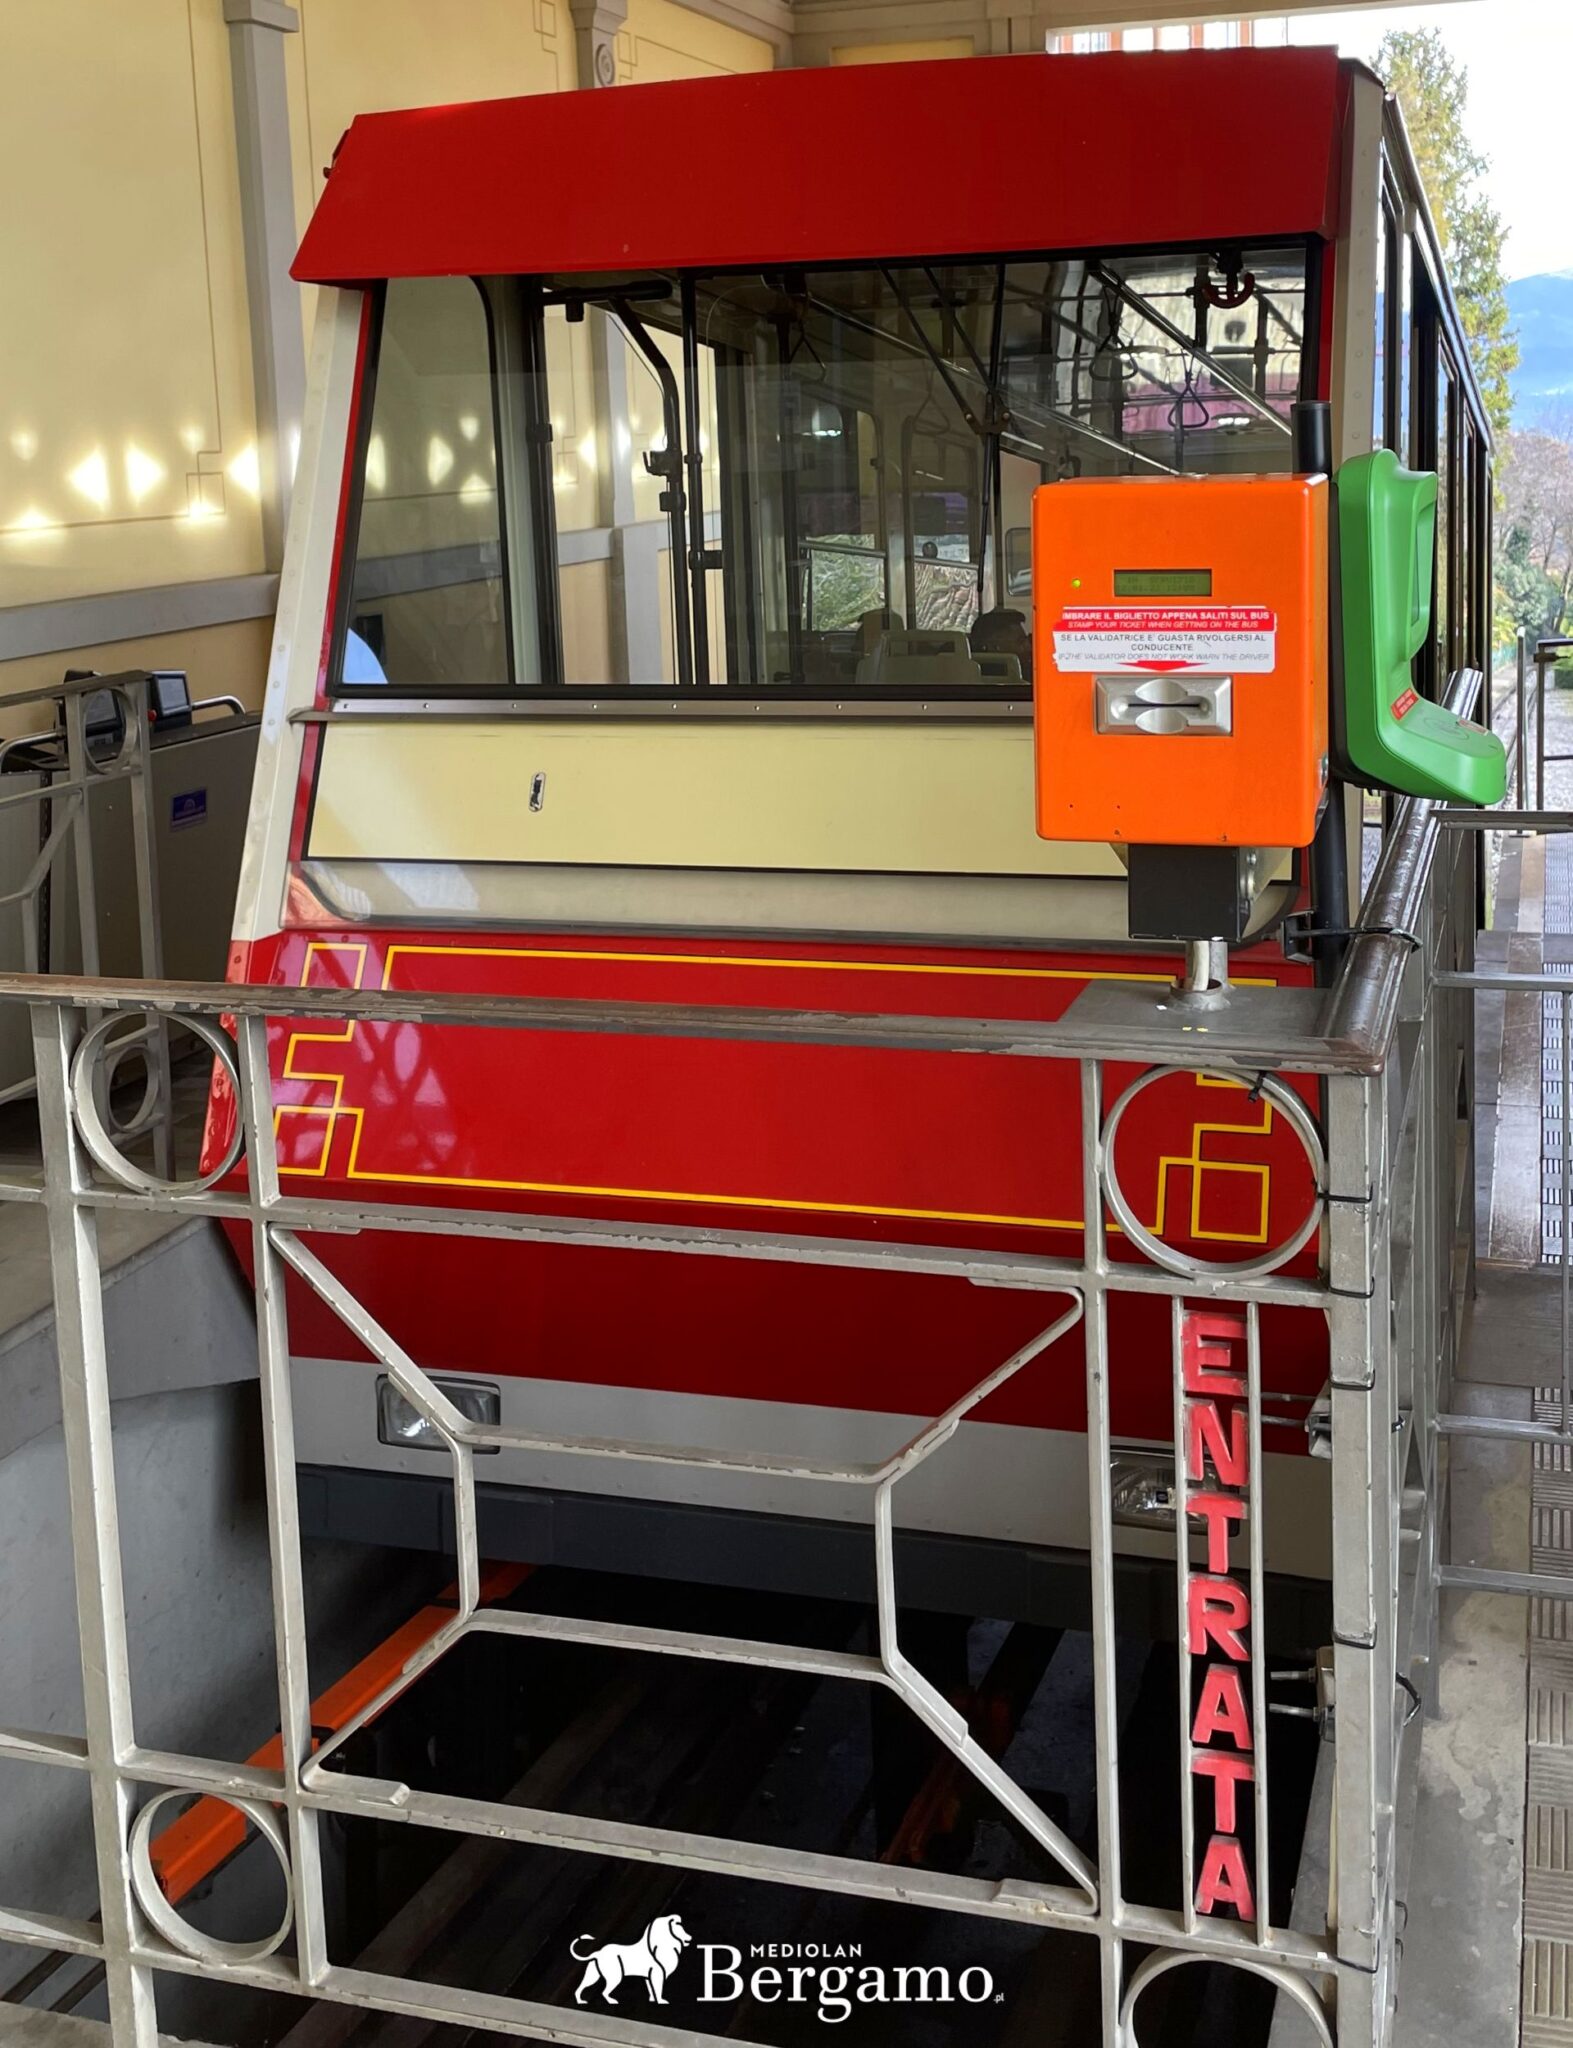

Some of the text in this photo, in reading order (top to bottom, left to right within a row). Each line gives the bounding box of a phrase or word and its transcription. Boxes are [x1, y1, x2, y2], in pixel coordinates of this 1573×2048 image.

[1103, 612, 1112, 620] IL
[1113, 612, 1160, 620] BIGLIETTO
[1161, 612, 1198, 620] APPENA
[1200, 612, 1228, 620] SALITI
[1230, 612, 1248, 620] SUL
[1250, 612, 1270, 620] BUS
[1068, 621, 1259, 629] STAMP YOUR TICKET WHEN GETTING ON THE BUS
[1130, 643, 1194, 651] CONDUCENTE
[1183, 1310, 1254, 1921] ENTRATA
